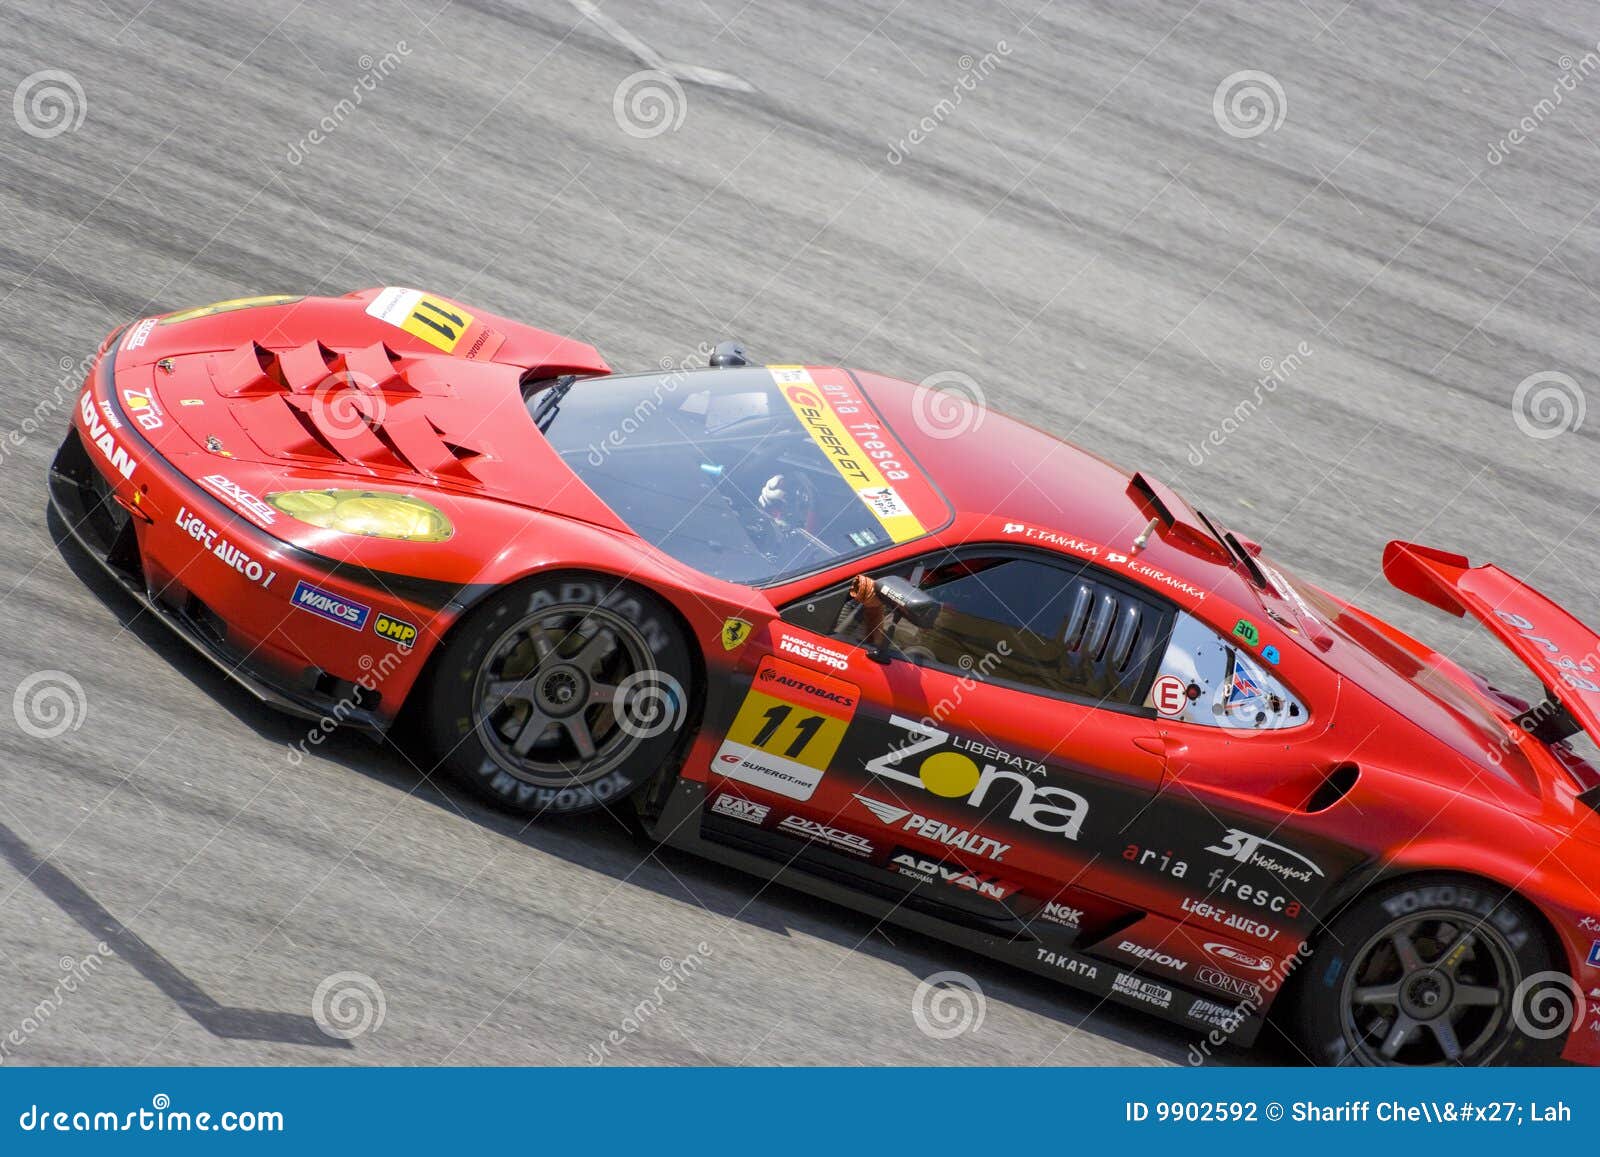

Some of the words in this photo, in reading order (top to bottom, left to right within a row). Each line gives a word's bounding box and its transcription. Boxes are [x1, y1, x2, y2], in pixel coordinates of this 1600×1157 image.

[412, 300, 465, 341] 11
[823, 384, 862, 414] aria
[801, 407, 849, 457] SUPER
[850, 422, 909, 481] fresca
[204, 474, 277, 523] DIXCEL
[213, 540, 264, 581] AUTO
[1024, 527, 1099, 556] T.TANAKA
[1127, 560, 1206, 600] K.HIRANAKA
[376, 618, 415, 641] OMP
[1236, 621, 1254, 640] 30
[780, 640, 849, 671] HASEPRO
[775, 675, 855, 706] AUTOBACS
[1160, 682, 1179, 710] E
[751, 704, 827, 759] 11
[952, 736, 1048, 777] LIBERATA
[741, 760, 813, 789] SUPERGT.net
[714, 795, 771, 819] RAYS
[780, 815, 874, 852] DIXCEL
[903, 814, 1013, 860] PENALTY
[892, 854, 1005, 898] ADVAN
[1122, 844, 1188, 878] aria
[1208, 868, 1301, 919] fresca
[1249, 851, 1314, 883] Motorsport
[1044, 902, 1085, 925] NGK
[1224, 913, 1270, 938] AUTO
[1036, 948, 1098, 980] TAKATA
[1117, 940, 1188, 971] BILLION
[1112, 983, 1170, 1009] MONITOR
[1114, 972, 1141, 991] REAR
[1144, 984, 1168, 999] VIEW
[1199, 968, 1257, 998] CORNES
